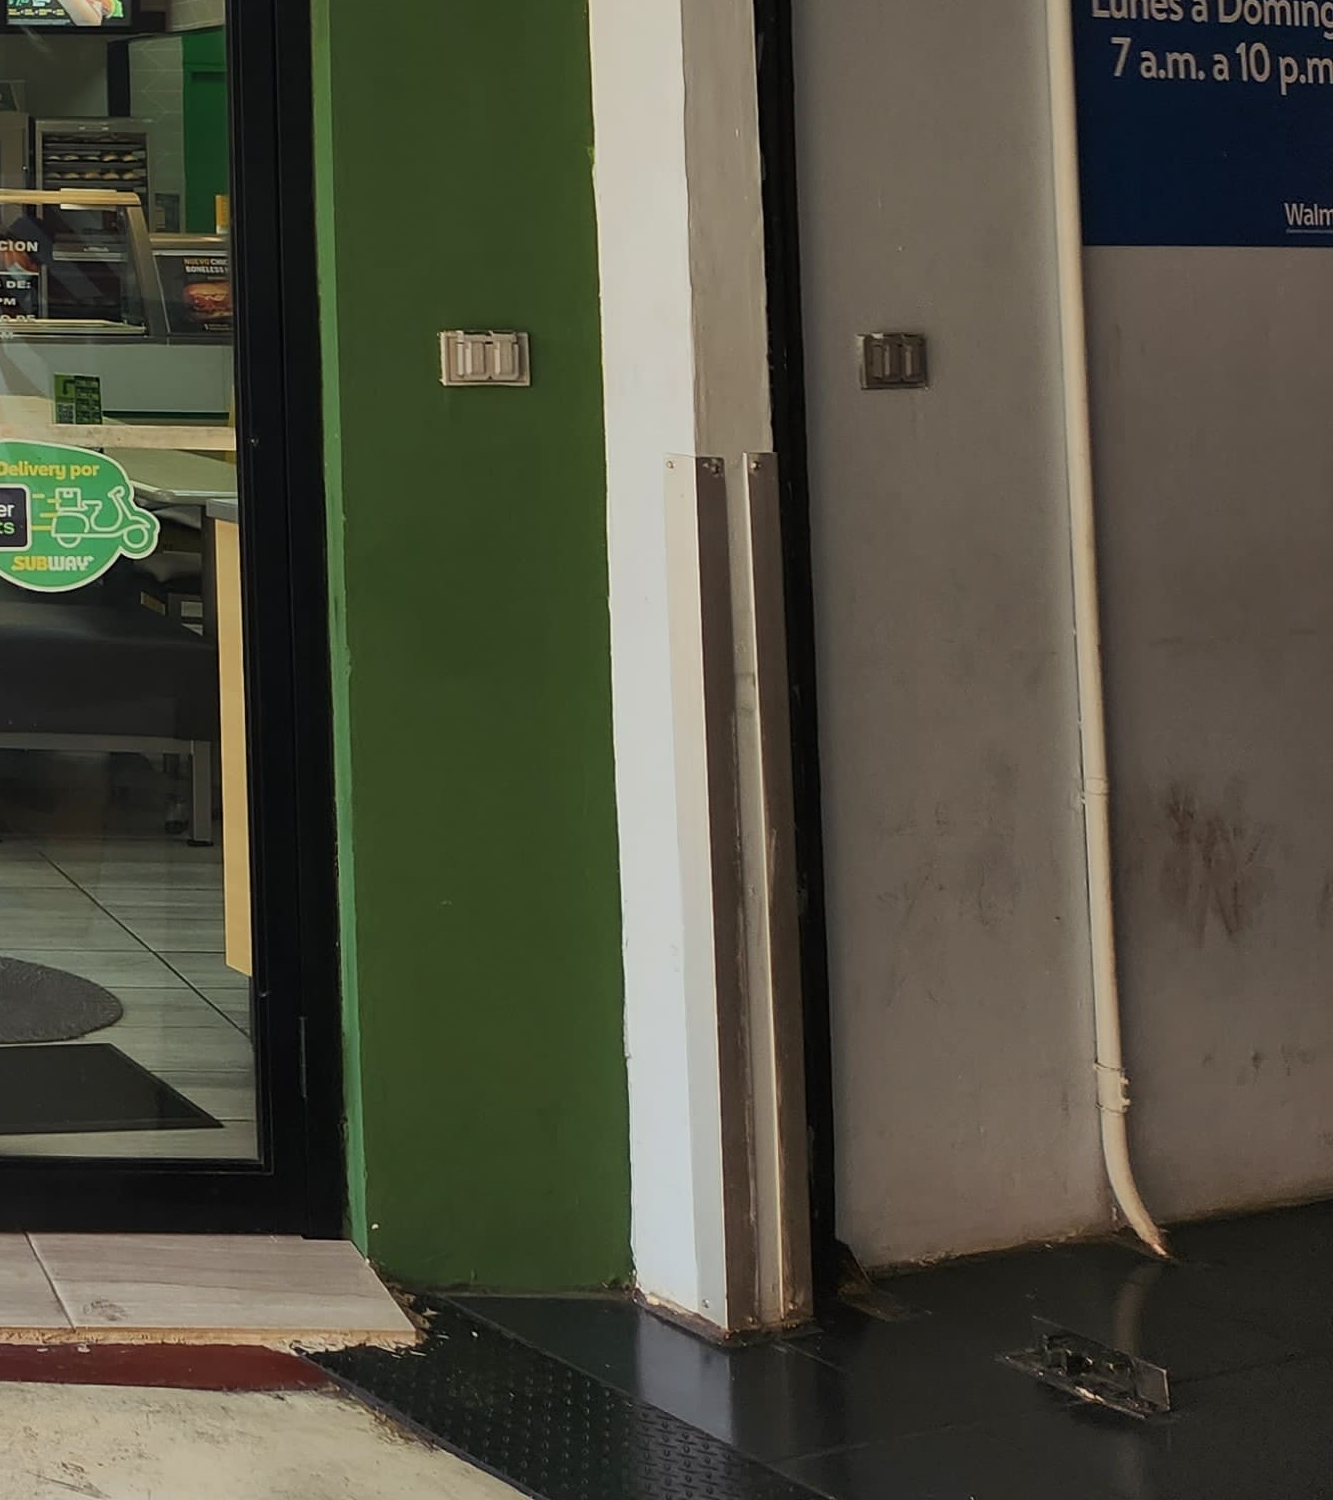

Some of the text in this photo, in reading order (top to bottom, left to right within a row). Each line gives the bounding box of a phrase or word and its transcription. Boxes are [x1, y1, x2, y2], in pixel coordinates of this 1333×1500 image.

[1109, 37, 1333, 96] 7 a.m. a 10 p.m
[1284, 203, 1333, 226] Walm
[6, 280, 31, 289] DE:
[70, 461, 100, 479] por
[10, 555, 95, 572] SUBWAY
